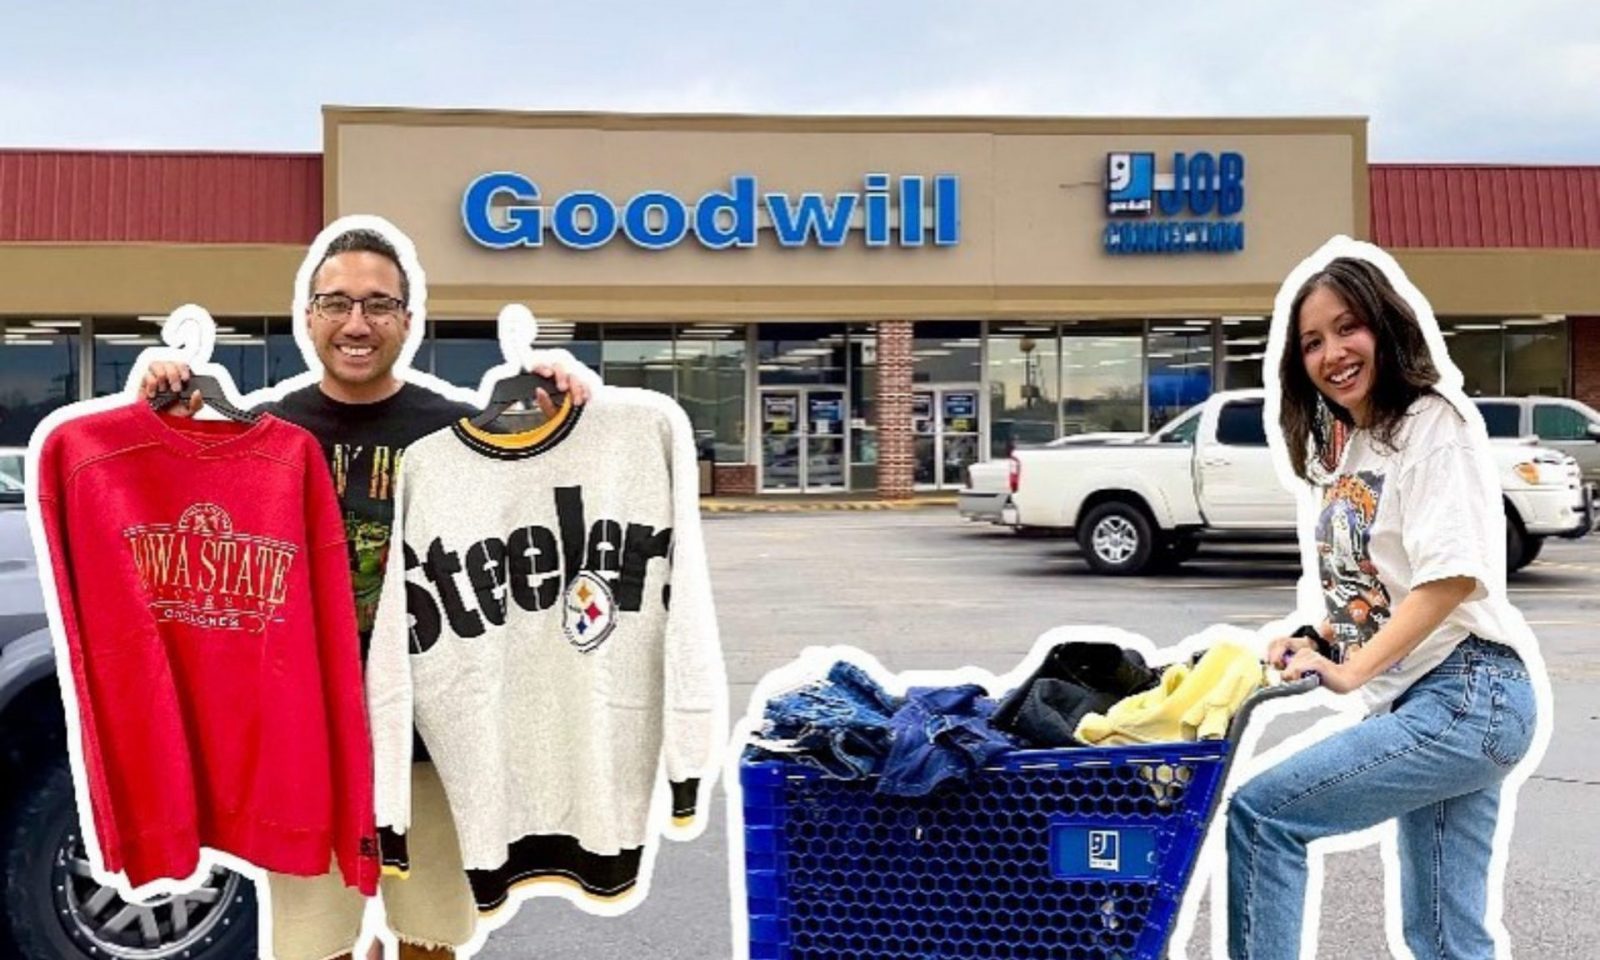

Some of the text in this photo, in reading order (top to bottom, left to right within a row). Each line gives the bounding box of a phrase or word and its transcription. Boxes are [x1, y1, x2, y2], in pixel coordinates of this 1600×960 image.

[461, 171, 961, 250] Goodwill
[1157, 152, 1244, 216] JOB
[198, 538, 294, 604] STATE
[403, 485, 673, 654] Steeler
